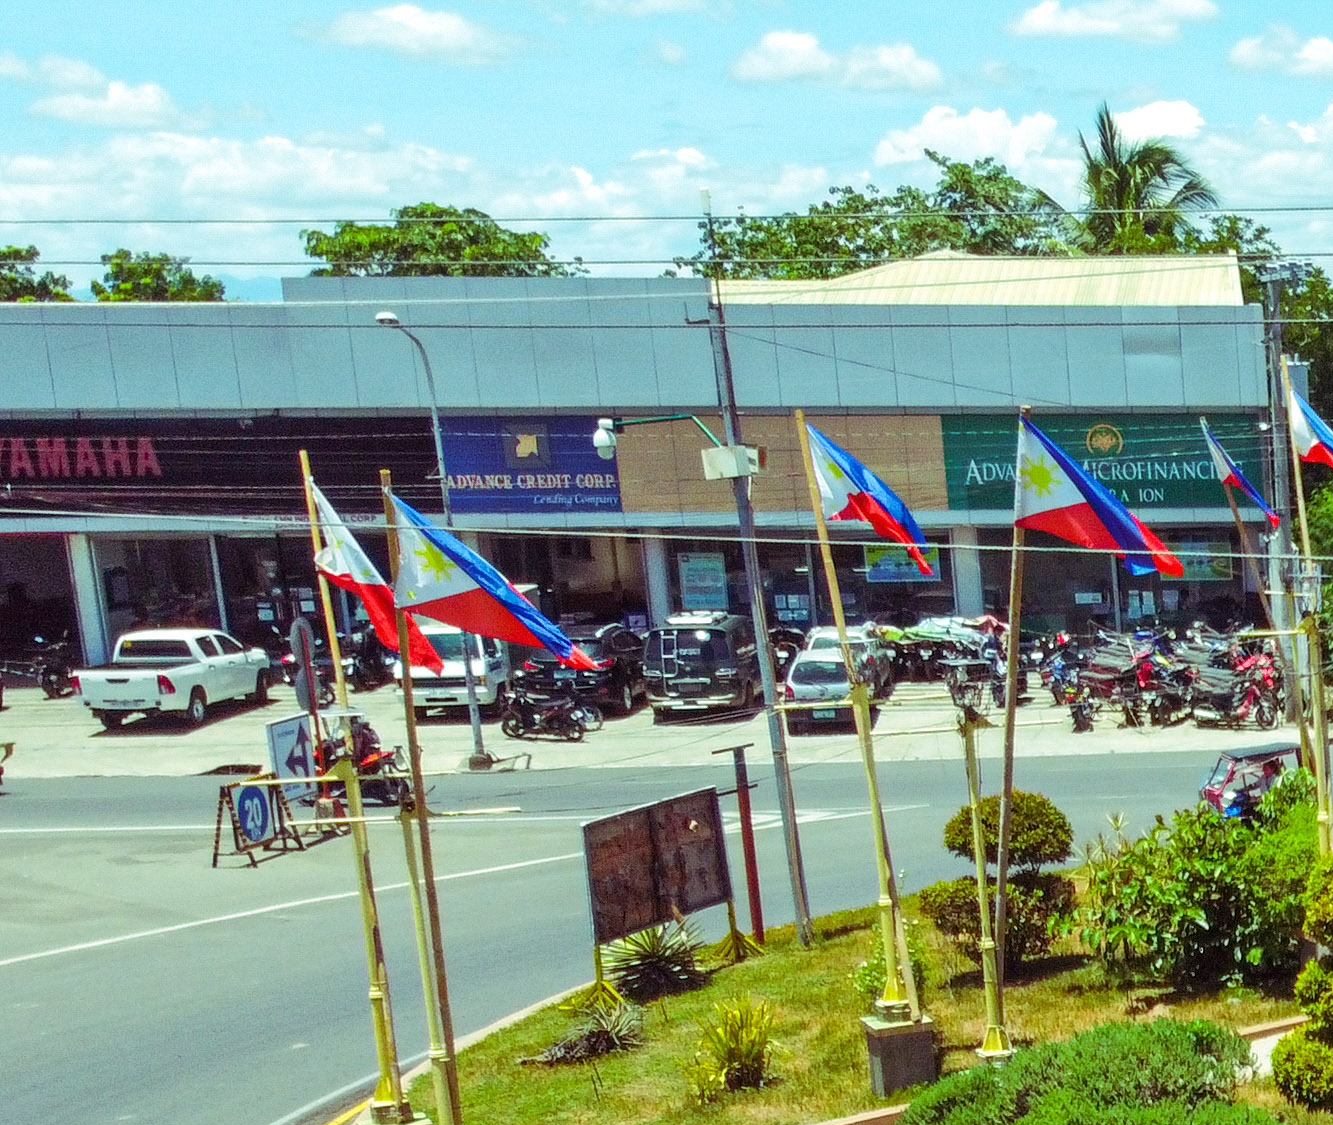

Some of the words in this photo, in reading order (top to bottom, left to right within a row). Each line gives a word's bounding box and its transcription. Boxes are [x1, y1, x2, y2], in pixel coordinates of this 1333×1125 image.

[0, 436, 163, 477] AMAHA
[447, 474, 513, 489] ADVANCE
[517, 474, 571, 488] CREDIT
[533, 494, 573, 506] Lending
[574, 494, 619, 507] Company
[244, 797, 263, 829] 20
